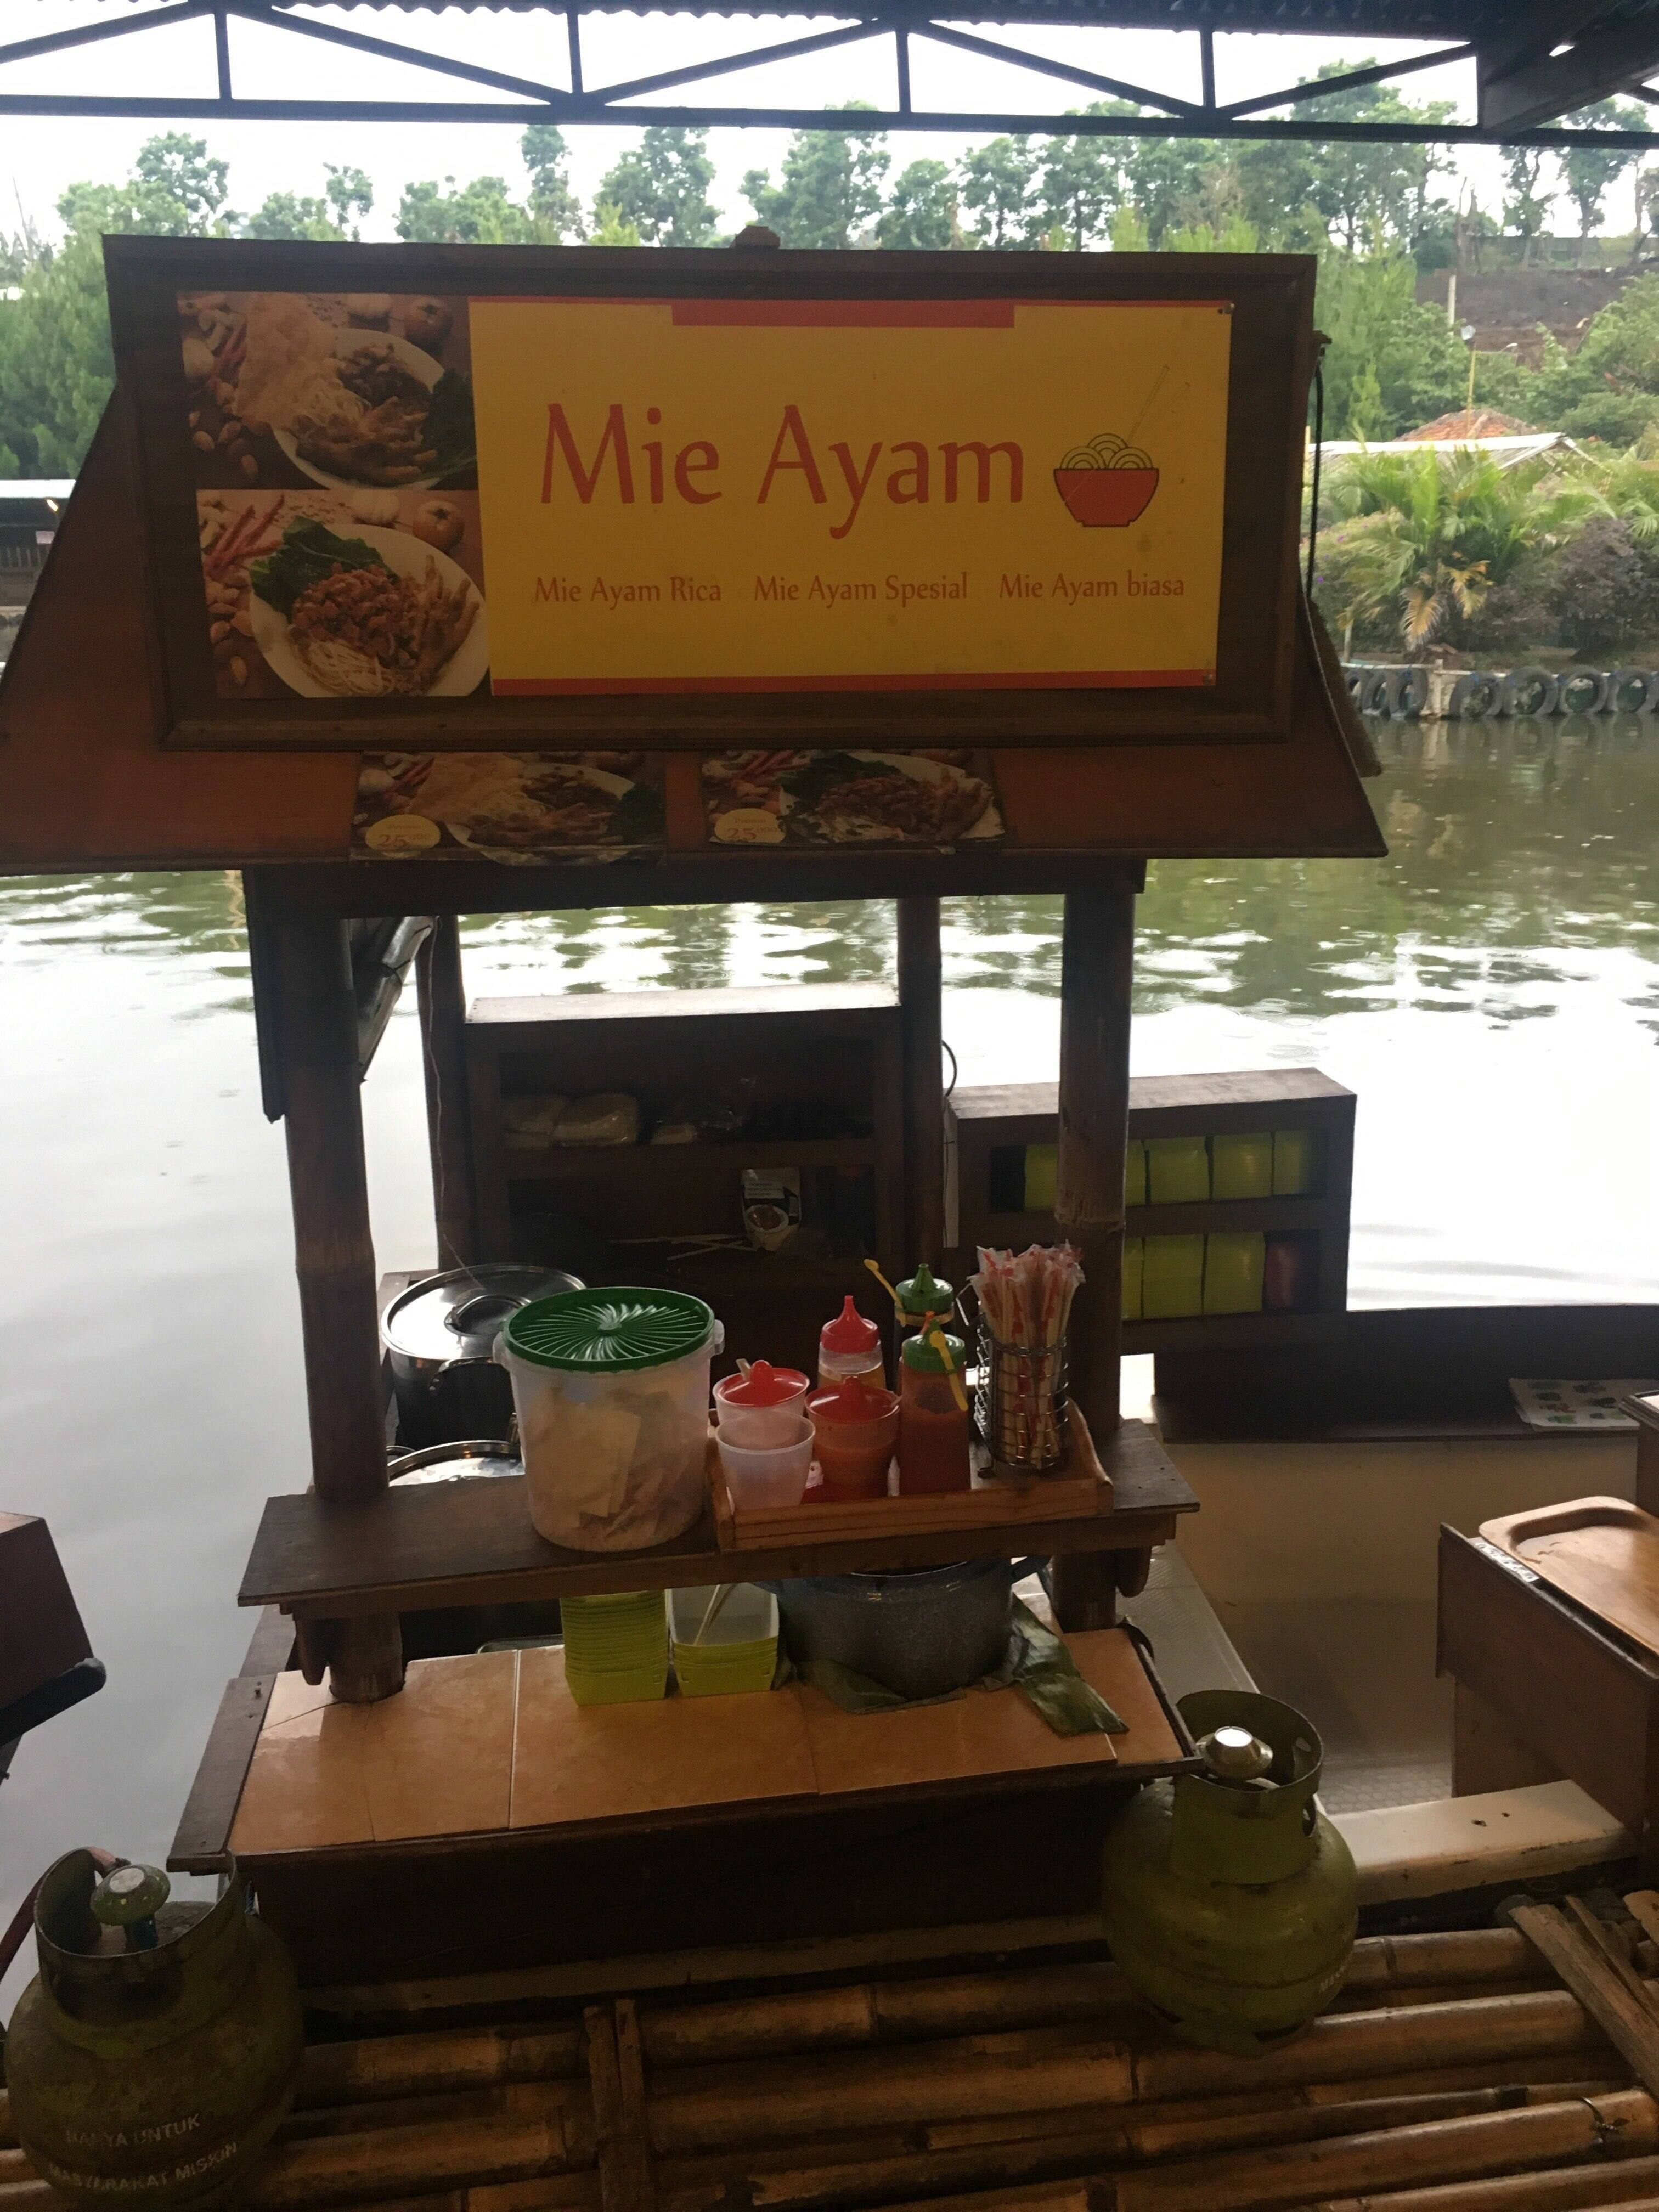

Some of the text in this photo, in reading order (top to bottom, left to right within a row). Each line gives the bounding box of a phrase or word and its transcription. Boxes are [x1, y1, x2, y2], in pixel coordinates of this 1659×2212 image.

[540, 402, 1024, 540] Mie Ayam
[534, 575, 722, 610] Mie Ayam Rica
[754, 571, 968, 608] Mie Ayam Spesial
[999, 570, 1185, 607] Mie Ayam biasa
[134, 2112, 201, 2145] UNTUK
[175, 2141, 237, 2180] MISKIN
